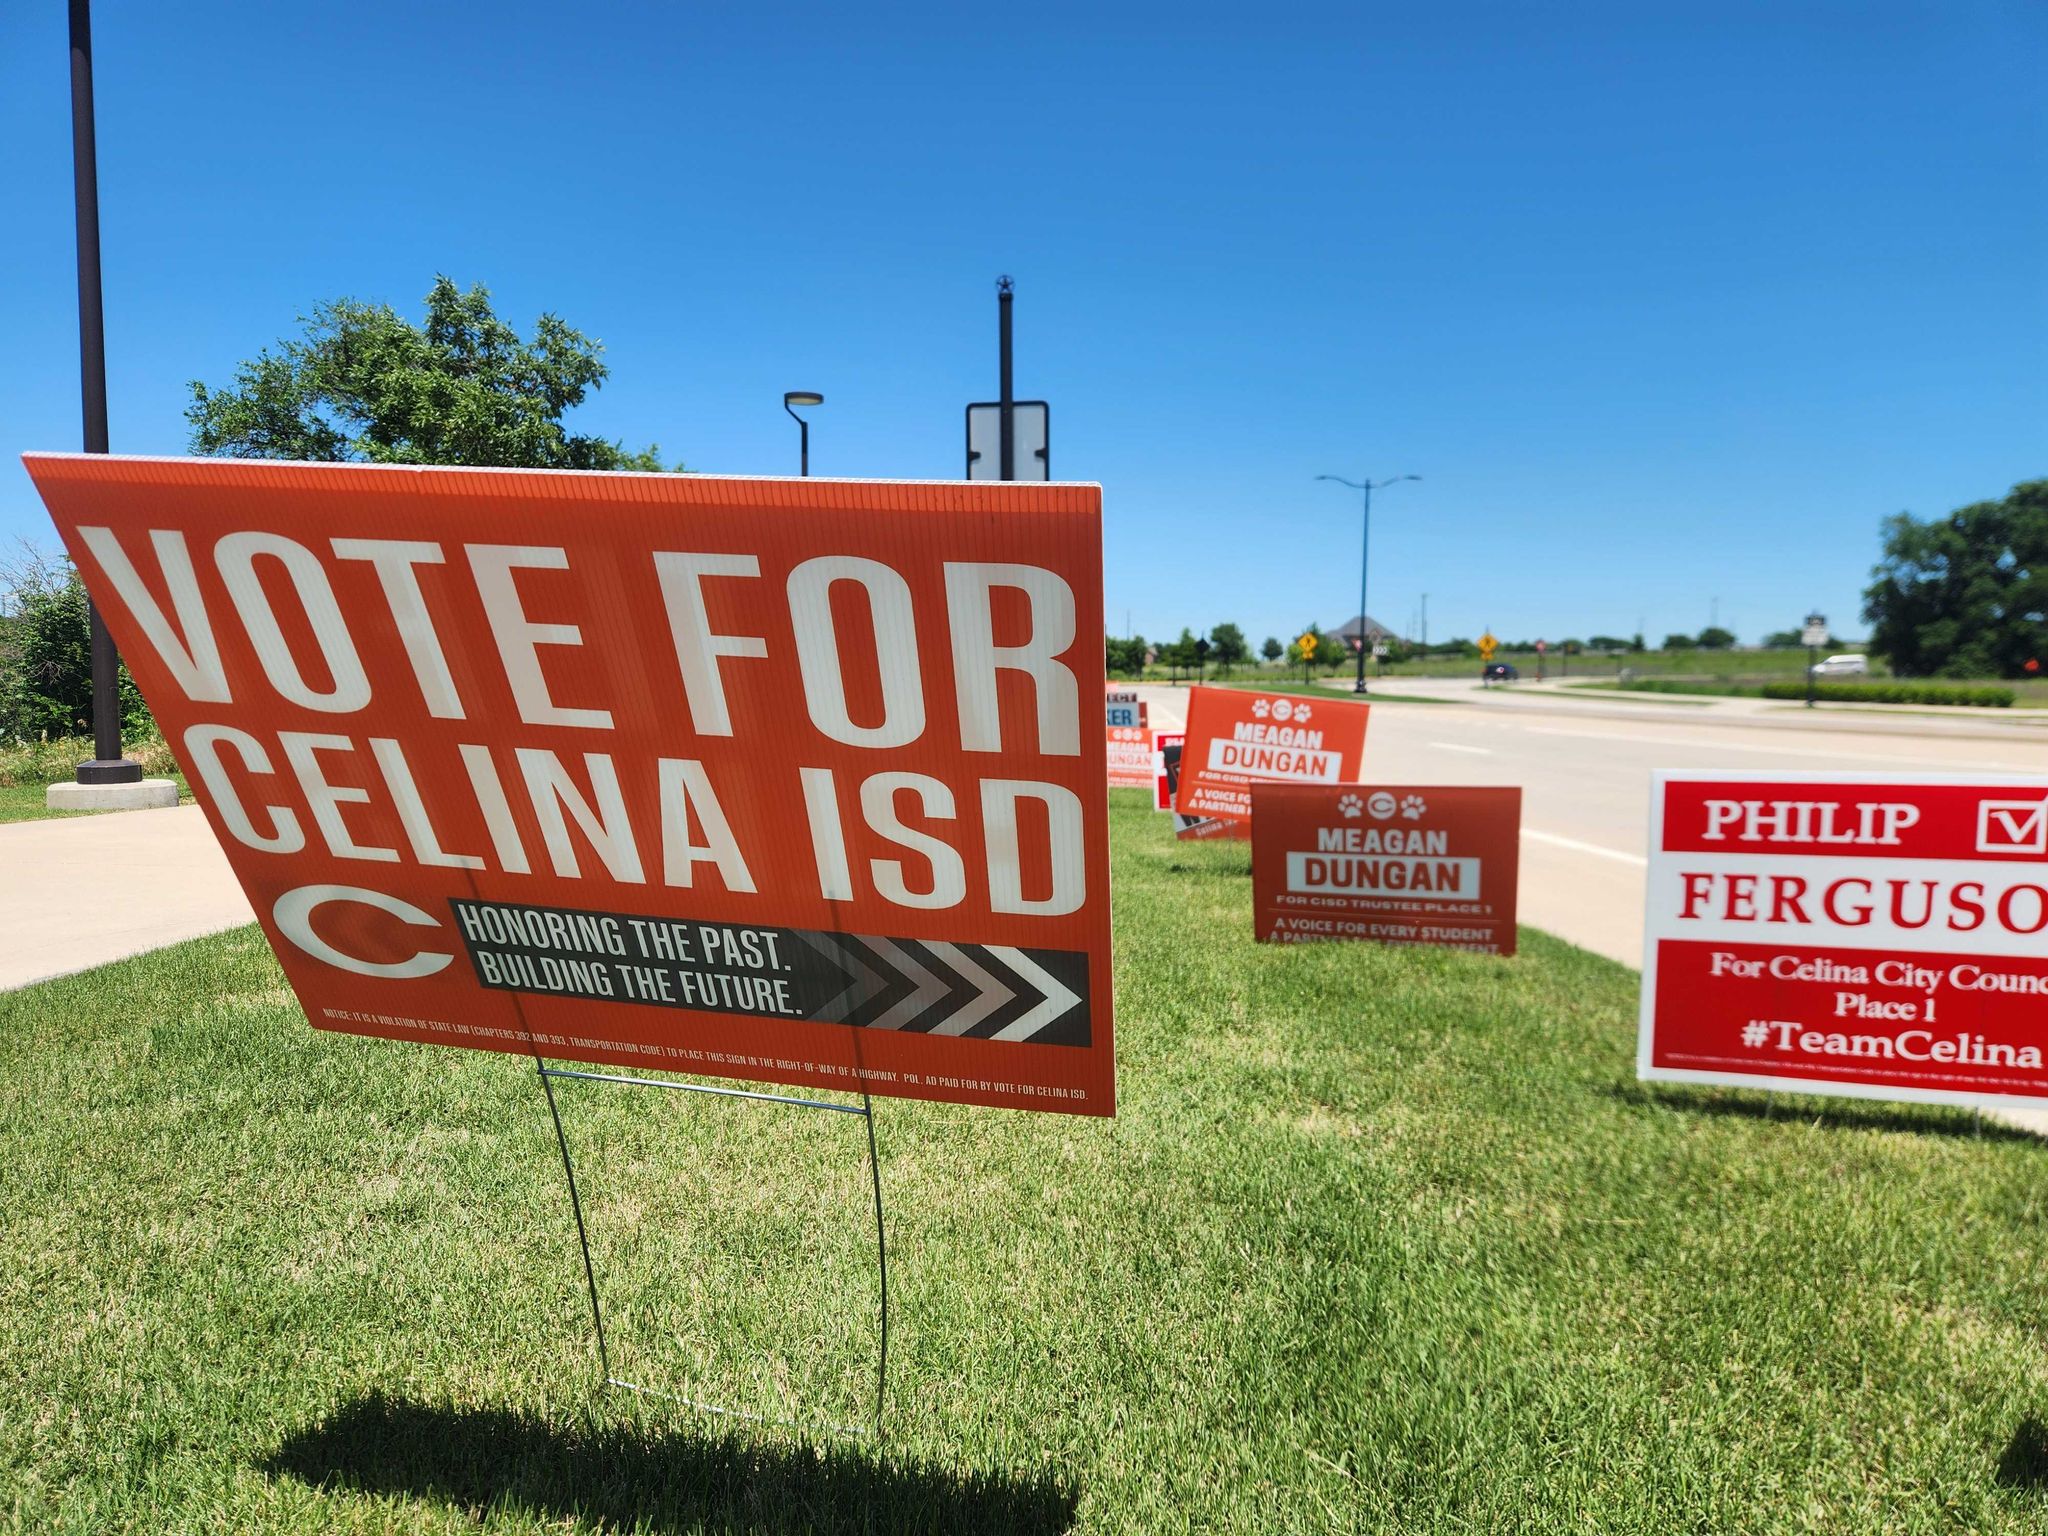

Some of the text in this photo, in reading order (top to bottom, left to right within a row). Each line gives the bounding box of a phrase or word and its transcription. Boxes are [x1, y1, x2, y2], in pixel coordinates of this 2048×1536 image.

[75, 525, 1080, 756] VOTE FOR
[1234, 722, 1323, 749] MEAGAN
[1107, 753, 1151, 766] UNGAN
[1222, 745, 1328, 777] DUNGAN
[1188, 798, 1198, 808] A
[1198, 799, 1246, 815] PARTNER
[1194, 788, 1203, 798] A
[1204, 789, 1236, 802] VOICE
[184, 723, 1086, 916] CELINA ISD
[1701, 799, 1920, 845] PHILIP
[1317, 827, 1448, 855] MEAGAN
[1304, 857, 1461, 892] DUNGAN
[1276, 895, 1493, 915] FOR CISD TRUSTEE PLACE 1
[273, 884, 455, 979] C
[457, 904, 793, 972] HONORING THE PAST.
[1275, 917, 1494, 940] A VOICE FOR EVERY STUDENT
[477, 950, 803, 1015] BUILDING THE FUTURE.
[1710, 952, 1765, 978] For
[1769, 955, 1870, 986] Celina
[1874, 960, 1944, 995] City
[1833, 992, 1937, 1023] Place 1
[322, 1008, 1089, 1100] NOTICE: IT IS A VIOLATION OF STATE LAW (CHAPTERS 392 AND 393, TRANSPORTATION CODE) TO PLACE THIS SIGN IN THE RIGHT-OF-WAY OF A HIGHWAY. POL. AD PAID FOR BY VOTE FOR CELINA ISD.
[1740, 1018, 2043, 1070] #TeamCelina
